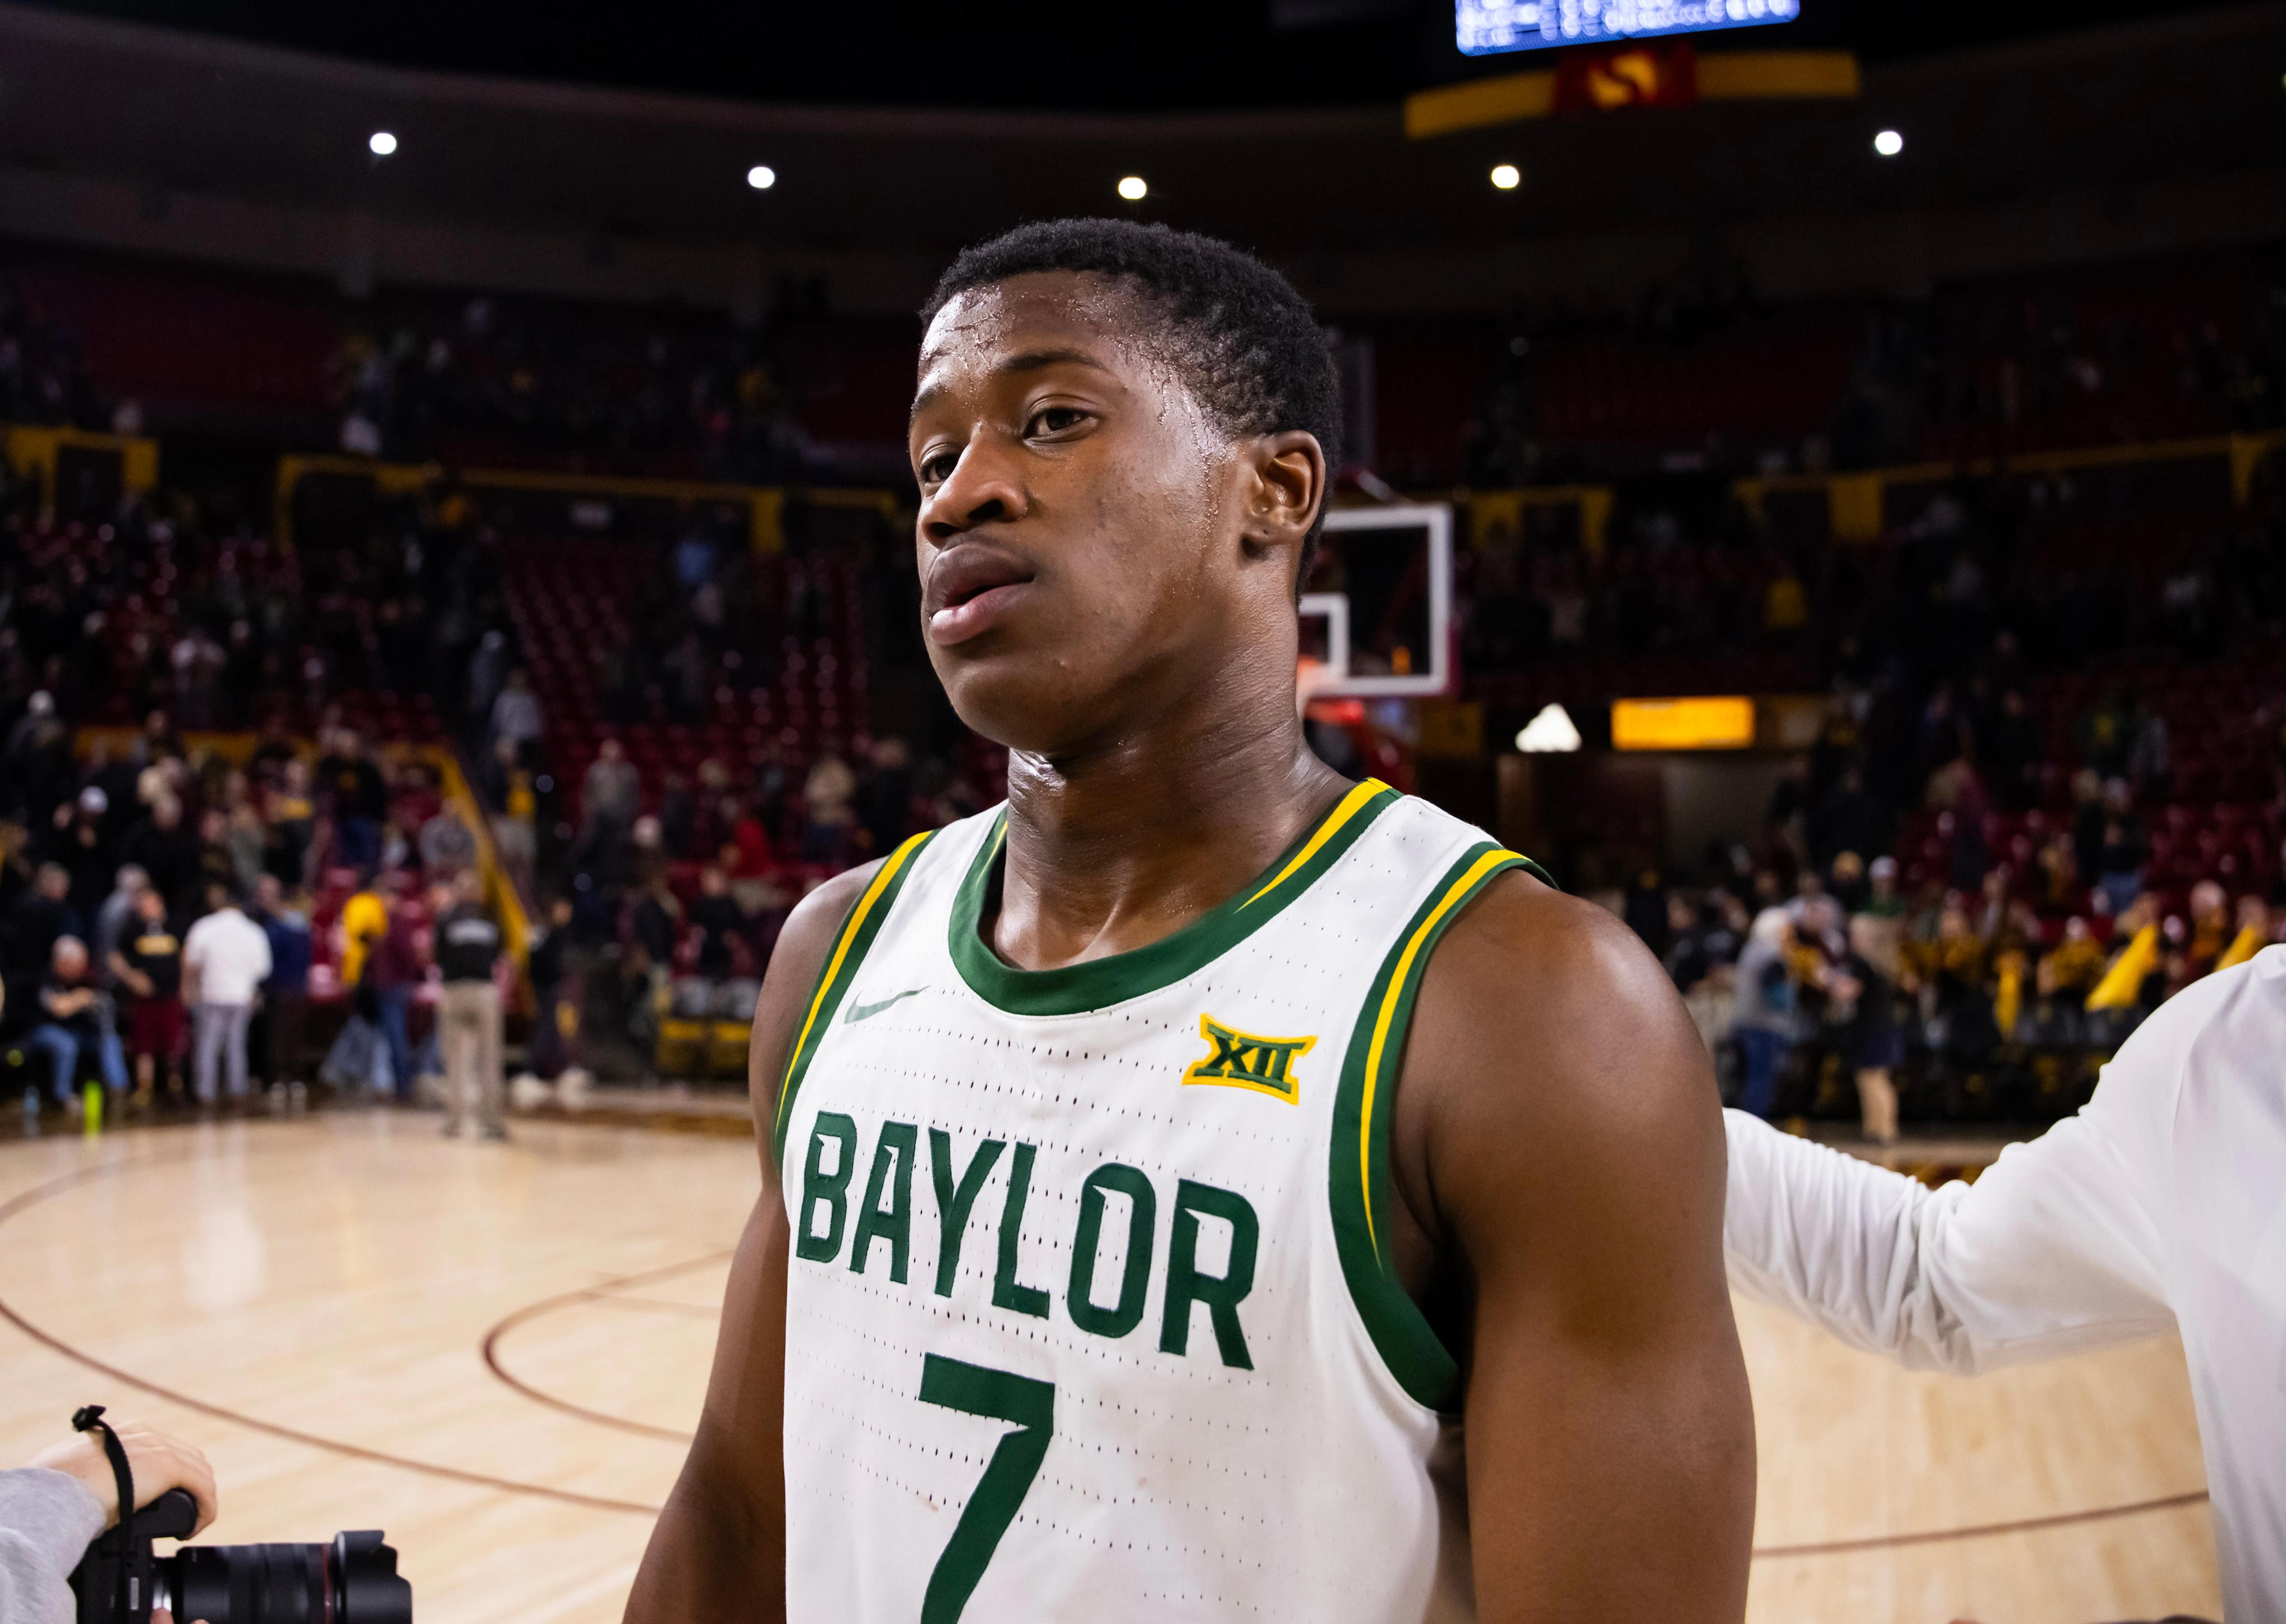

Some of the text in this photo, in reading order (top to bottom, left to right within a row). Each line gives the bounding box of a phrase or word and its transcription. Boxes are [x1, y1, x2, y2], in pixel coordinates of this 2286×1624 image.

[1193, 1022, 1306, 1094] XII
[796, 1111, 1259, 1370] BAYLOR
[919, 1352, 1055, 1624] 7
